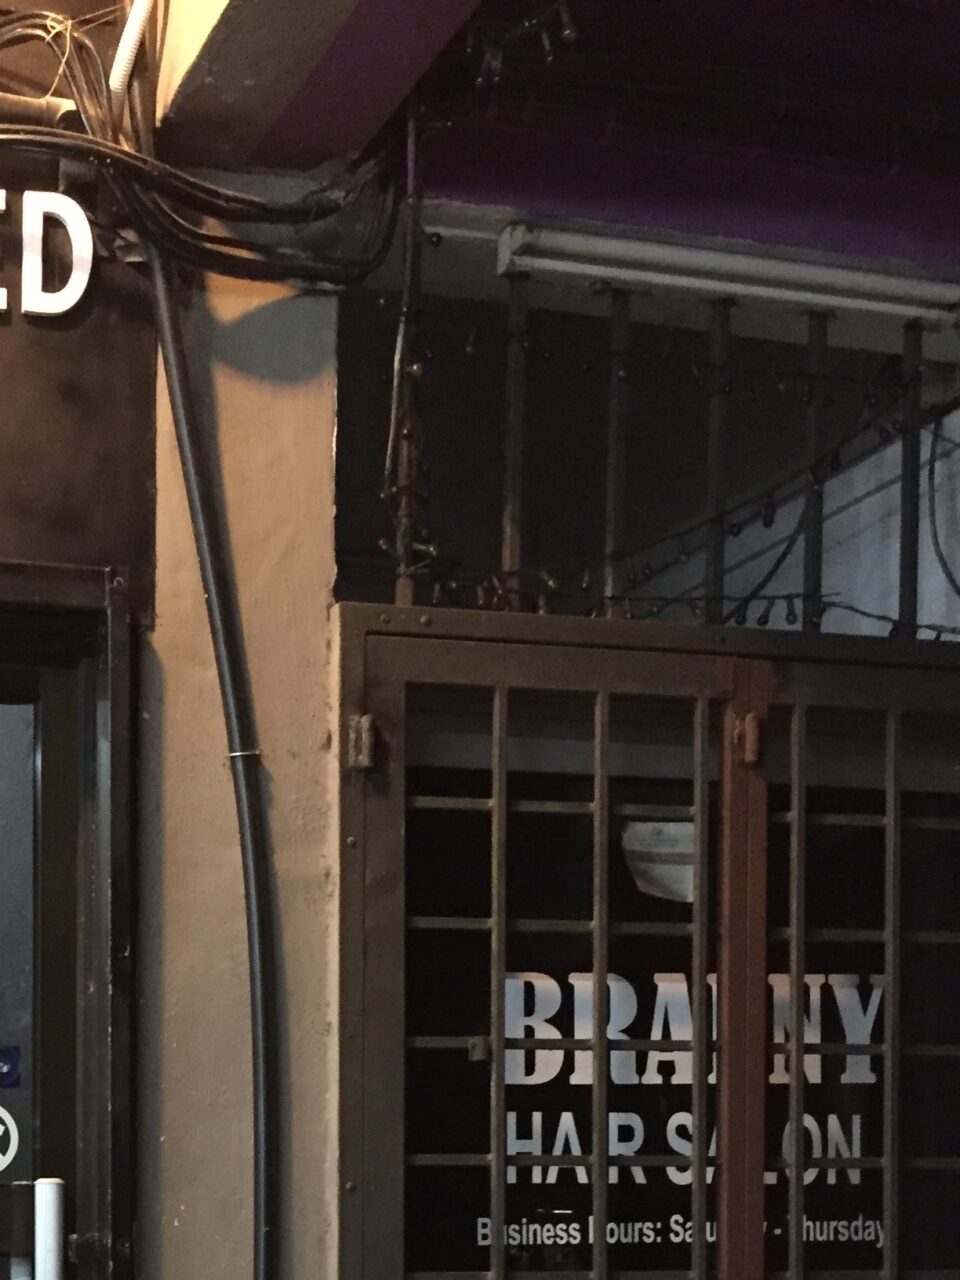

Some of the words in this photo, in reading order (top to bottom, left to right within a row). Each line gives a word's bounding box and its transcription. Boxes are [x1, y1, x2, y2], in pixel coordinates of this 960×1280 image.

[504, 971, 890, 1085] BRANY
[506, 1111, 647, 1185] HAR
[666, 1111, 861, 1186] SON
[476, 1217, 581, 1247] Bsiness
[790, 1212, 884, 1249] hursday
